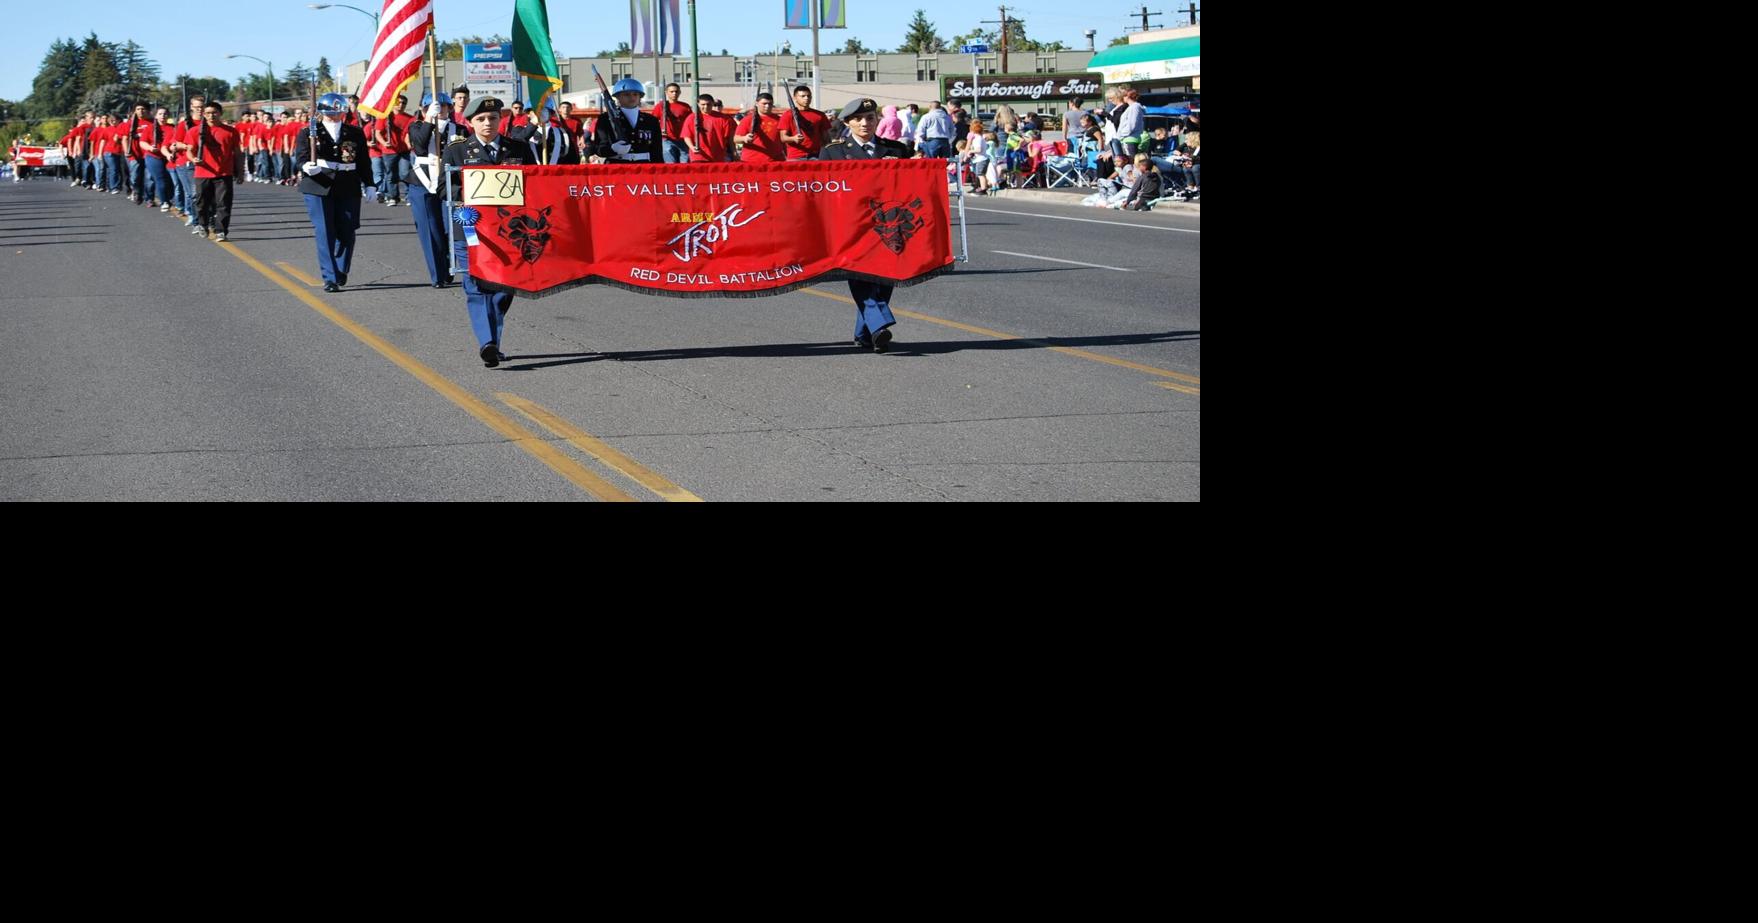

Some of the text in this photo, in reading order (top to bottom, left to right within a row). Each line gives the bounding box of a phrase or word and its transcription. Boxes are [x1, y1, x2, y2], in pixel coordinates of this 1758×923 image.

[1059, 79, 1099, 94] Fair
[568, 180, 852, 197] EAST VALLEY HIGH SCHOOL
[671, 212, 714, 222] ARMY
[667, 203, 765, 262] JROTC
[630, 263, 803, 285] RED DEVIL BATTALION
